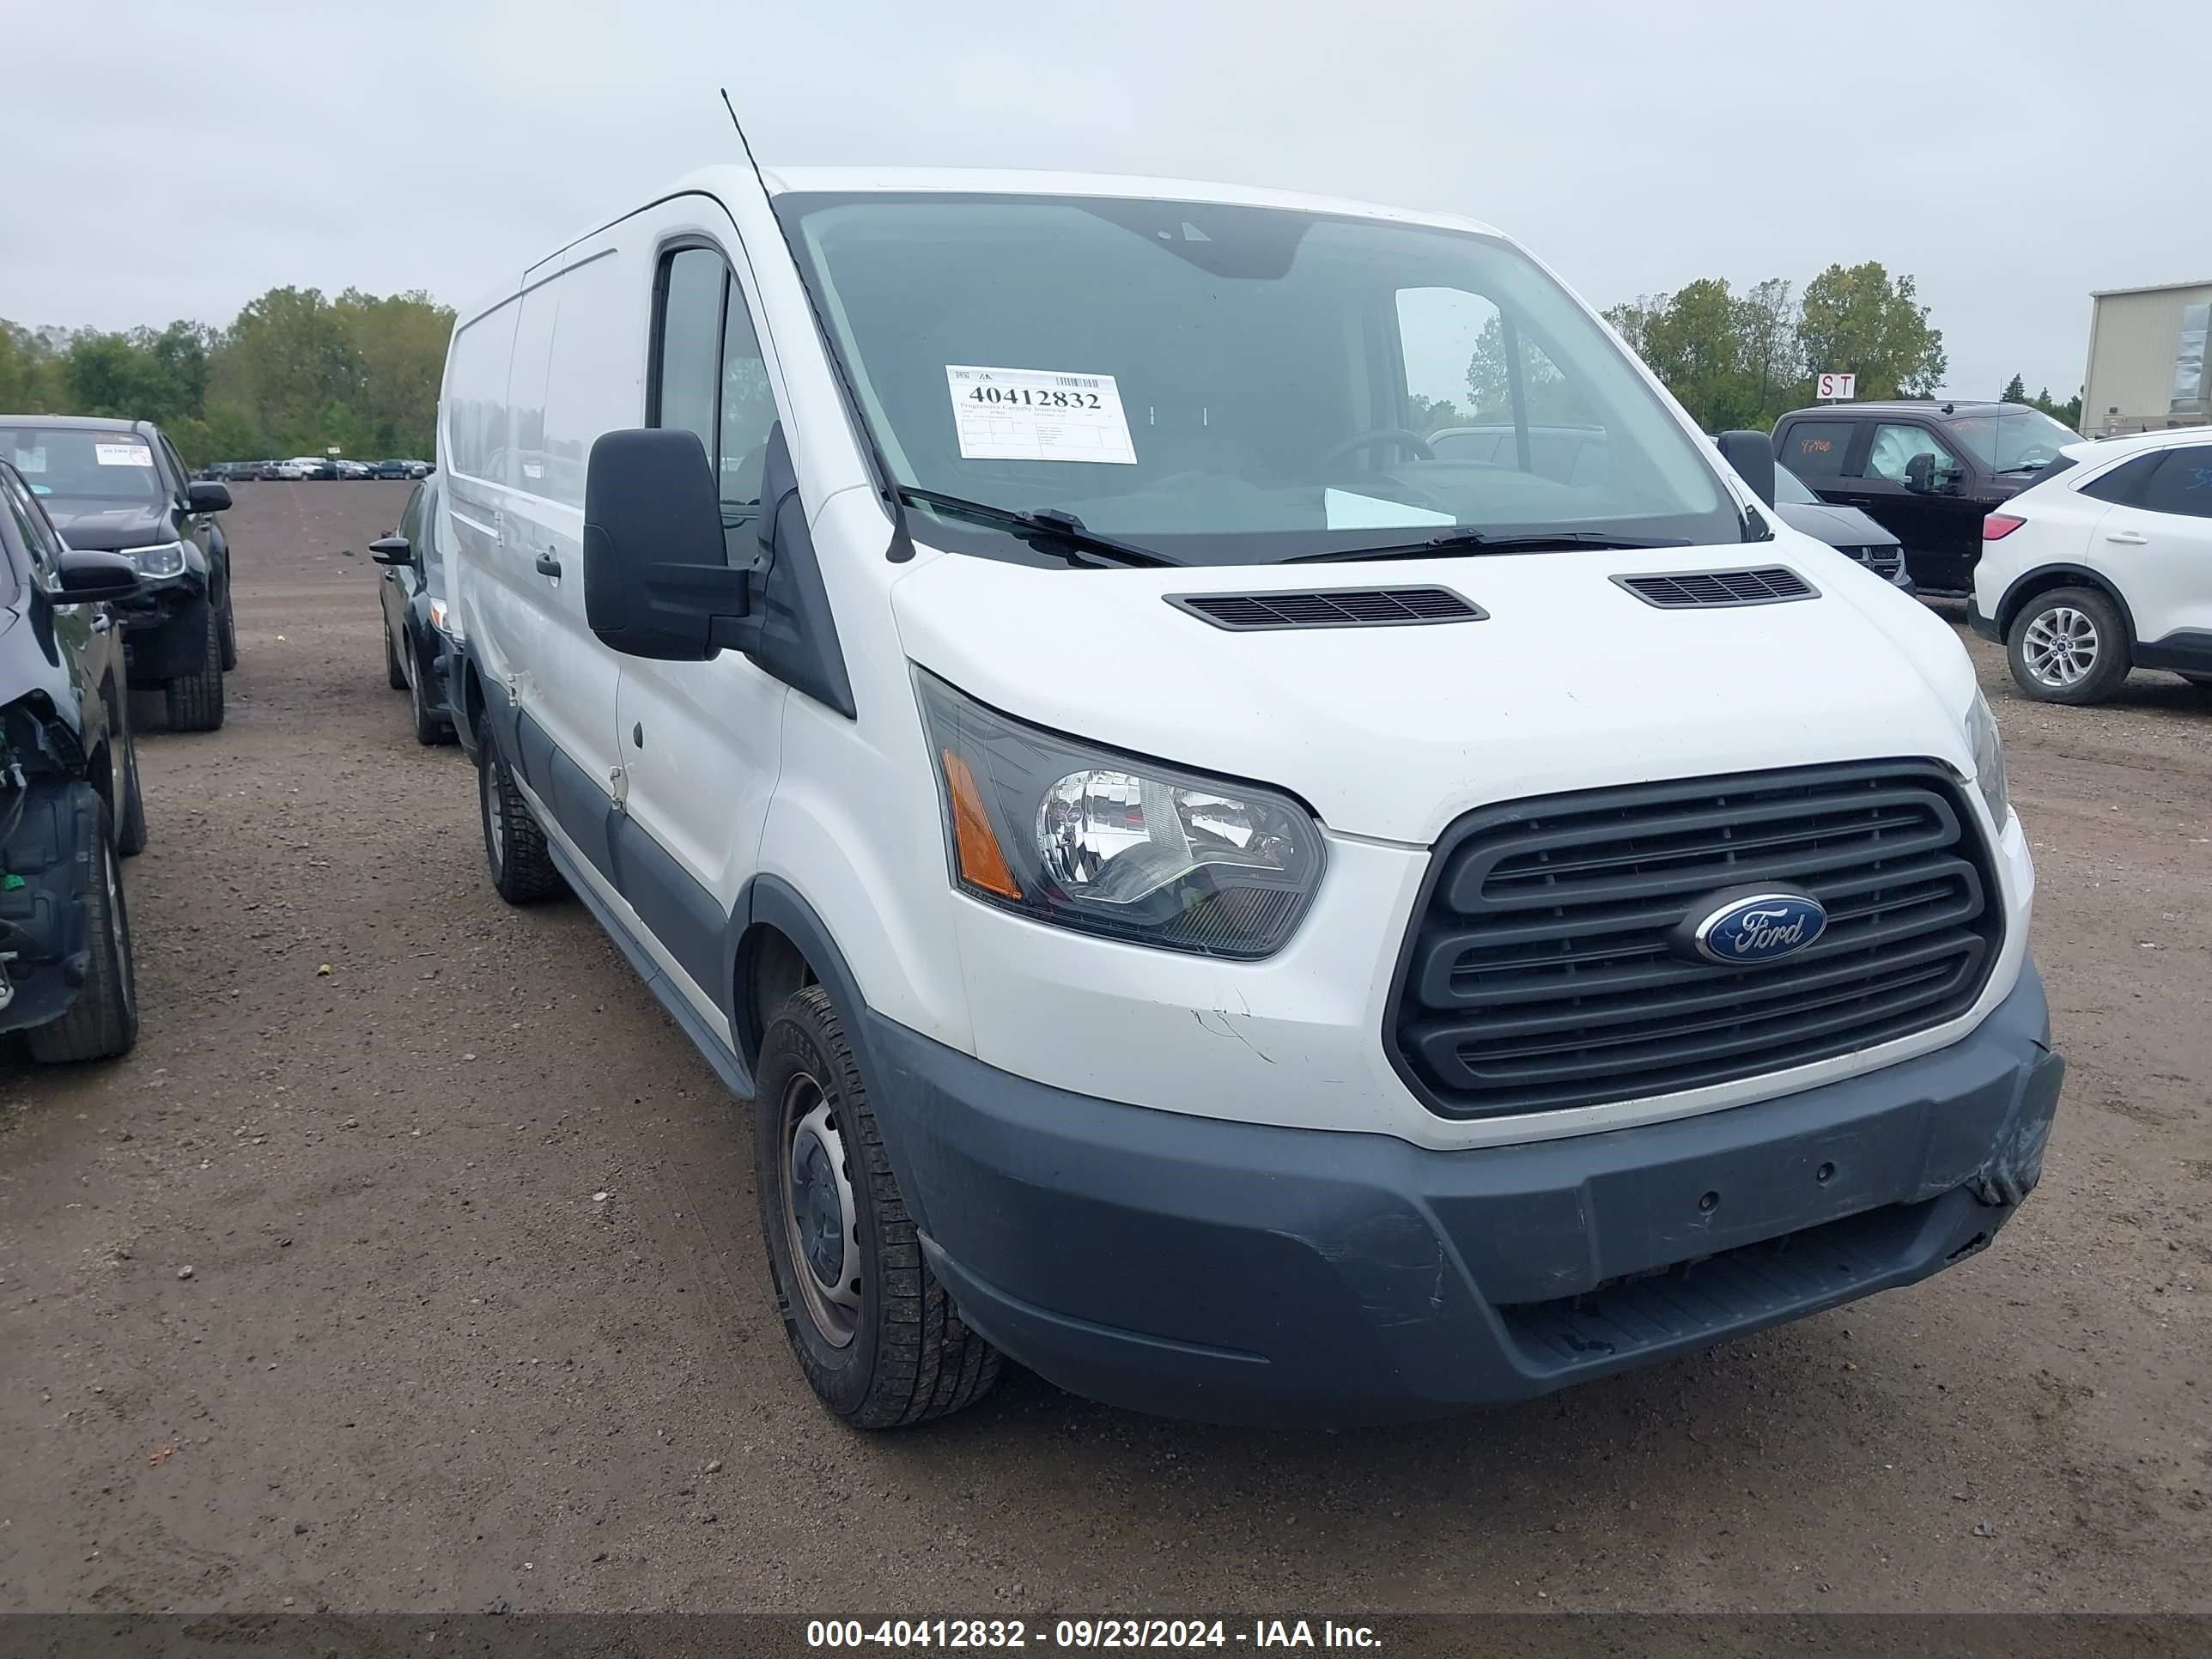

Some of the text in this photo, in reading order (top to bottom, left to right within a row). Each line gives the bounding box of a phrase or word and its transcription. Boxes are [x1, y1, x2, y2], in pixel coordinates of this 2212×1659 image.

[1821, 375, 1851, 396] S T
[969, 386, 1101, 410] 40412832
[1735, 908, 1806, 953] Ford
